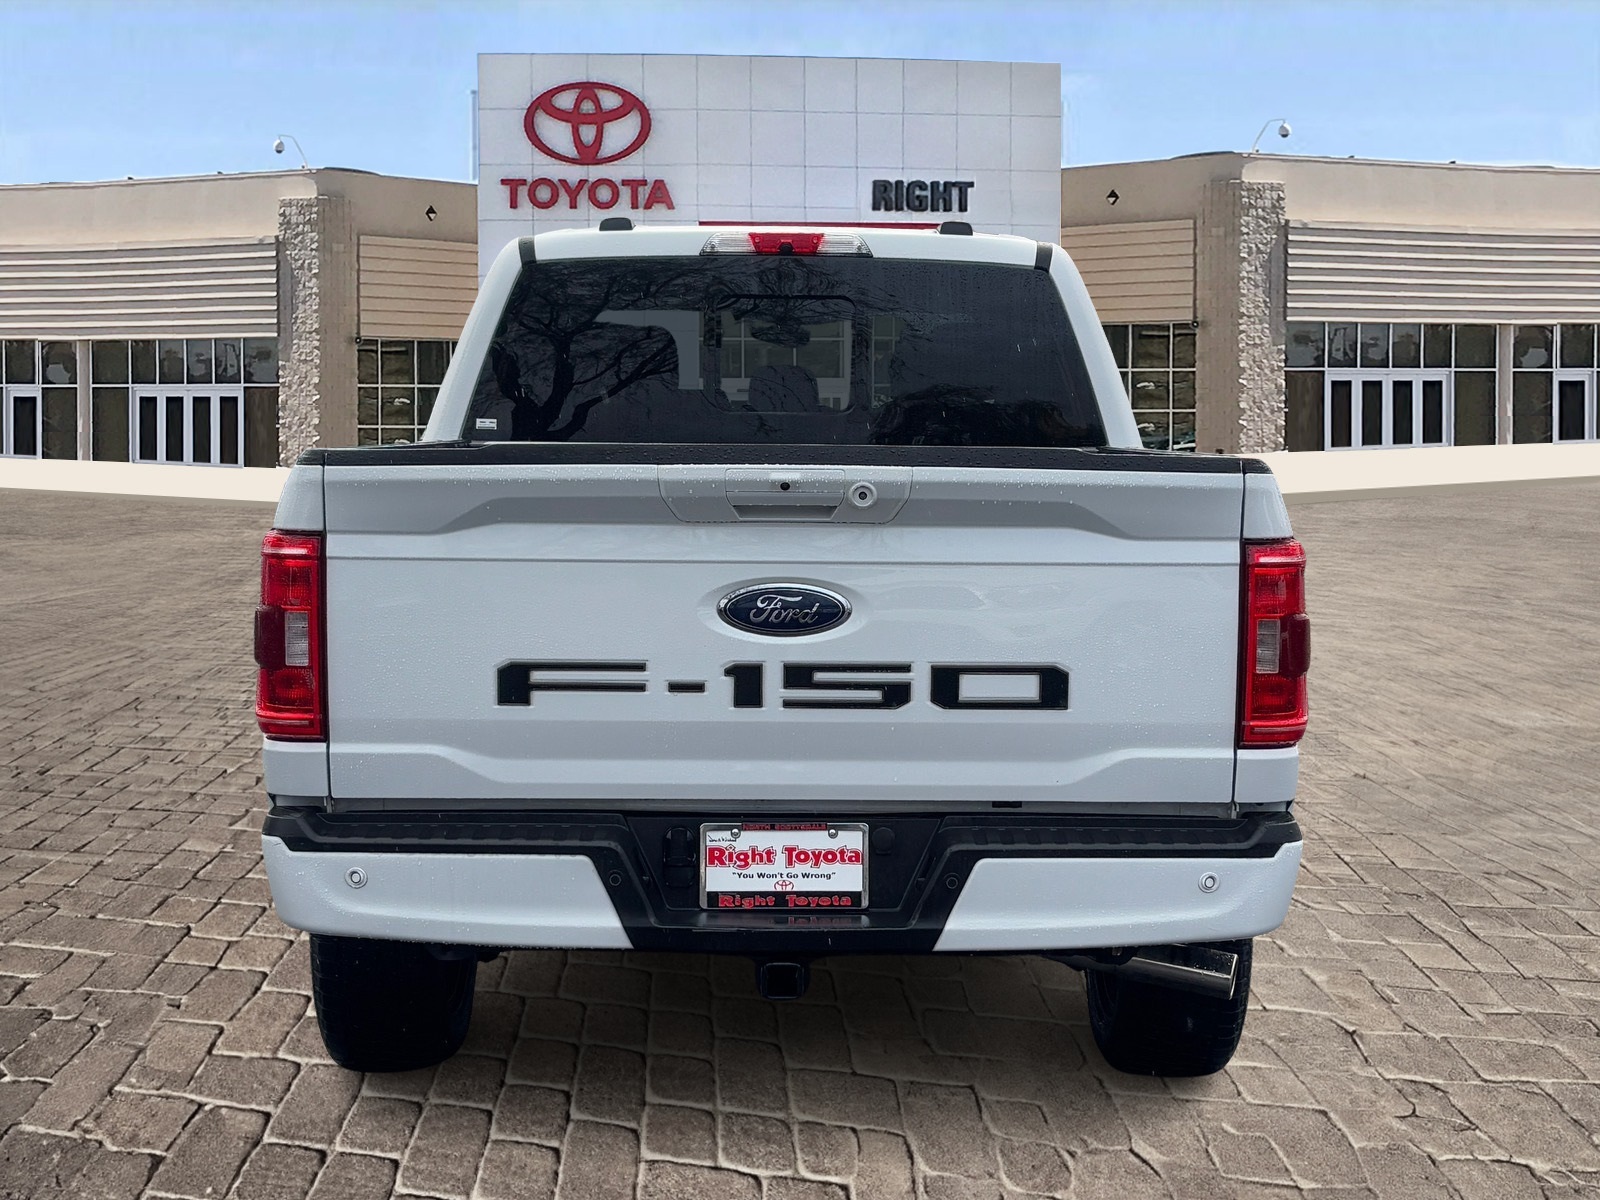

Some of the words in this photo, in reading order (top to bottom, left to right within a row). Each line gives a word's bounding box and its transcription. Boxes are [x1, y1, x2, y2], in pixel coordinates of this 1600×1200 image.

[500, 178, 675, 211] TOYOTA
[871, 179, 975, 213] RIGHT
[749, 594, 820, 624] Ford
[496, 660, 1070, 711] F-150
[706, 844, 776, 870] Right
[782, 844, 863, 869] Toyota
[718, 894, 776, 909] Right
[785, 894, 852, 908] Toyota
